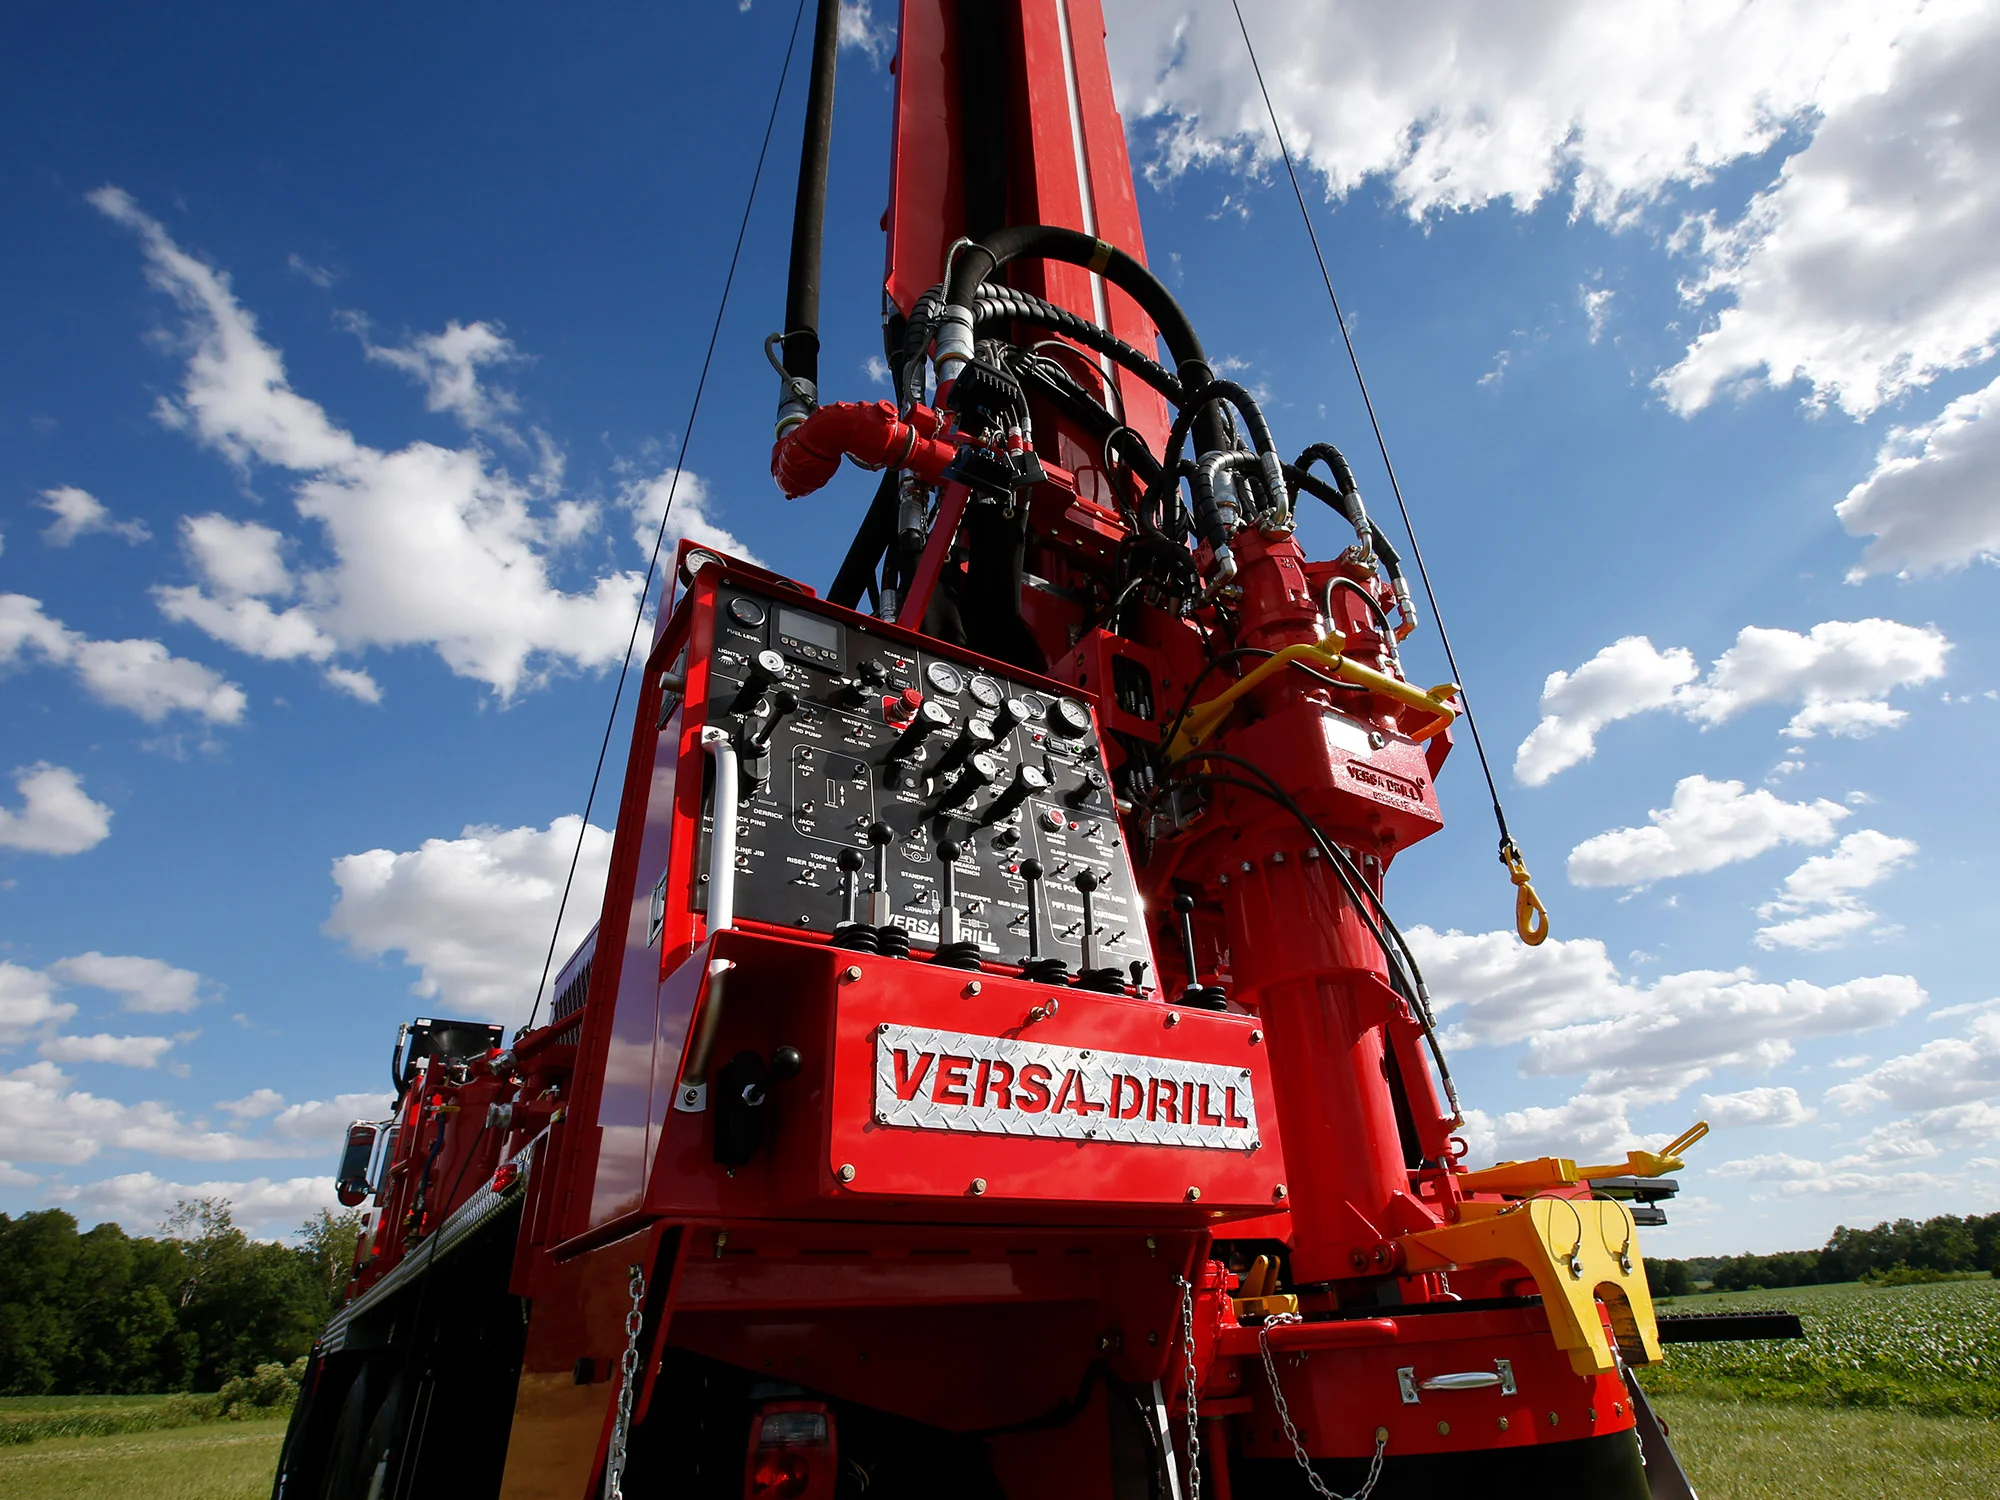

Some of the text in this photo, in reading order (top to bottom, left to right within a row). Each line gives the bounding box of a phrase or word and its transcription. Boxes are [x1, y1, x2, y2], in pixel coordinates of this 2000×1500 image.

[726, 628, 761, 643] FUEL LEVEL
[891, 666, 909, 675] FAULT
[796, 721, 816, 731] REMOTE
[789, 726, 822, 739] MUD PUMP
[843, 737, 857, 745] AUX.
[797, 763, 815, 772] JACK
[900, 763, 916, 771] FLOW
[851, 778, 868, 787] JACK
[902, 790, 919, 799] FOAM
[896, 795, 927, 807] INJECTION
[753, 807, 784, 820] DERRICK
[1086, 804, 1110, 815] PRESSURE
[749, 818, 767, 827] PINS
[797, 818, 816, 827] JACK
[905, 842, 925, 852] TABLE
[810, 852, 838, 863] TOPHEA
[786, 856, 807, 867] RISER
[808, 861, 828, 871] SLIDE
[954, 866, 980, 877] WRENCH
[1000, 871, 1012, 879] TOP
[900, 871, 934, 883] STANDPIPE
[1045, 880, 1062, 891] PIPE
[960, 892, 992, 904] STANDPIPE
[997, 899, 1010, 907] MUD
[905, 905, 932, 915] EXHAUST
[1051, 900, 1066, 910] PIPE
